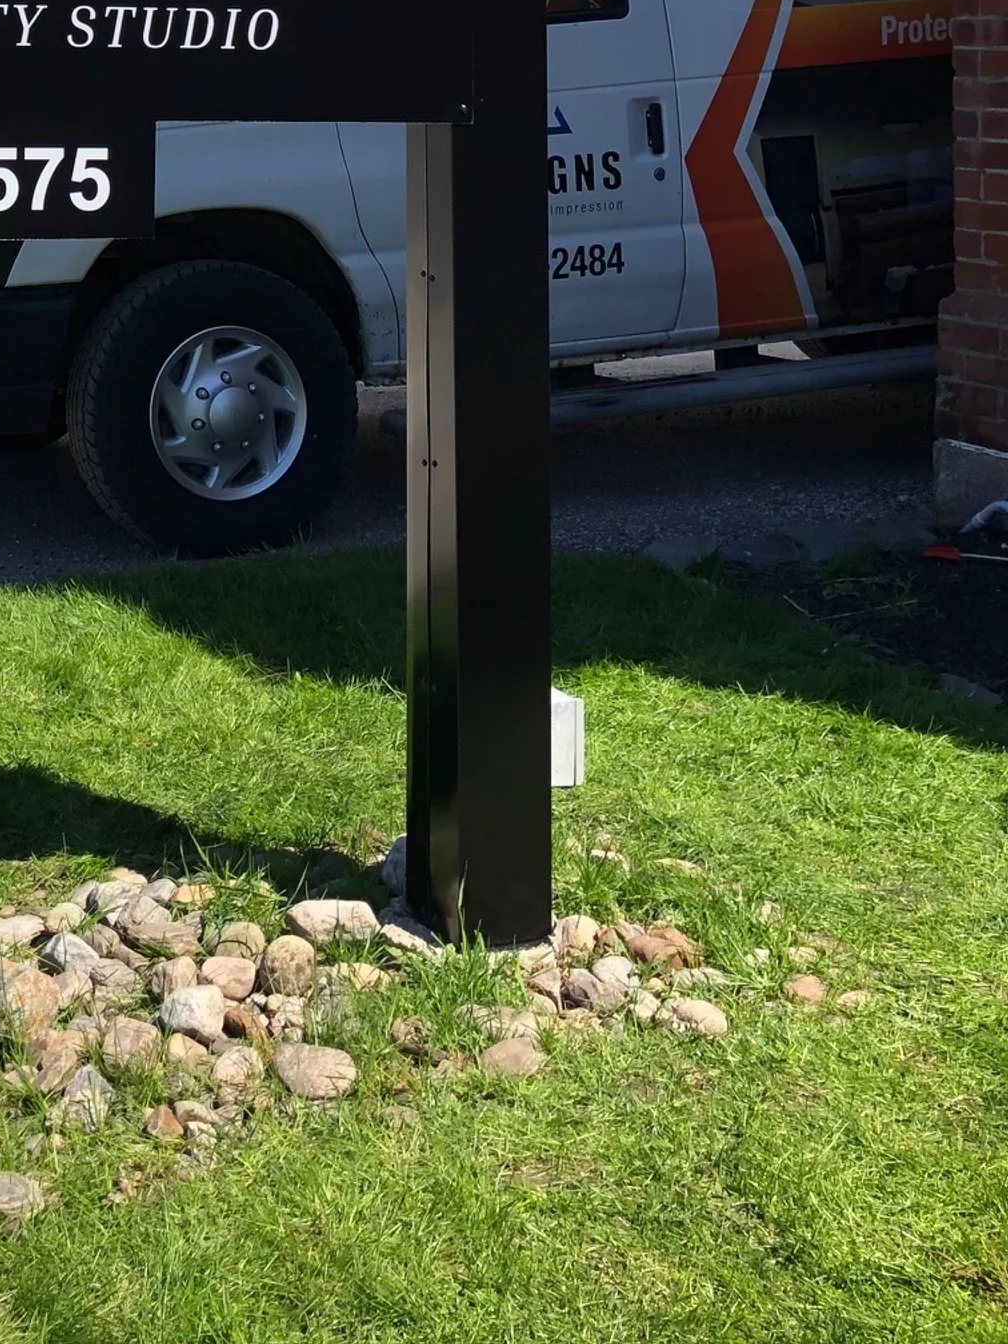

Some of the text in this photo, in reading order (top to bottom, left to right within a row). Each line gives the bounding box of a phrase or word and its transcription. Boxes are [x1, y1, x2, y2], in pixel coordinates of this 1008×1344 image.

[66, 5, 279, 51] STUDIO
[547, 151, 622, 194] GNS
[548, 242, 625, 279] 2484
